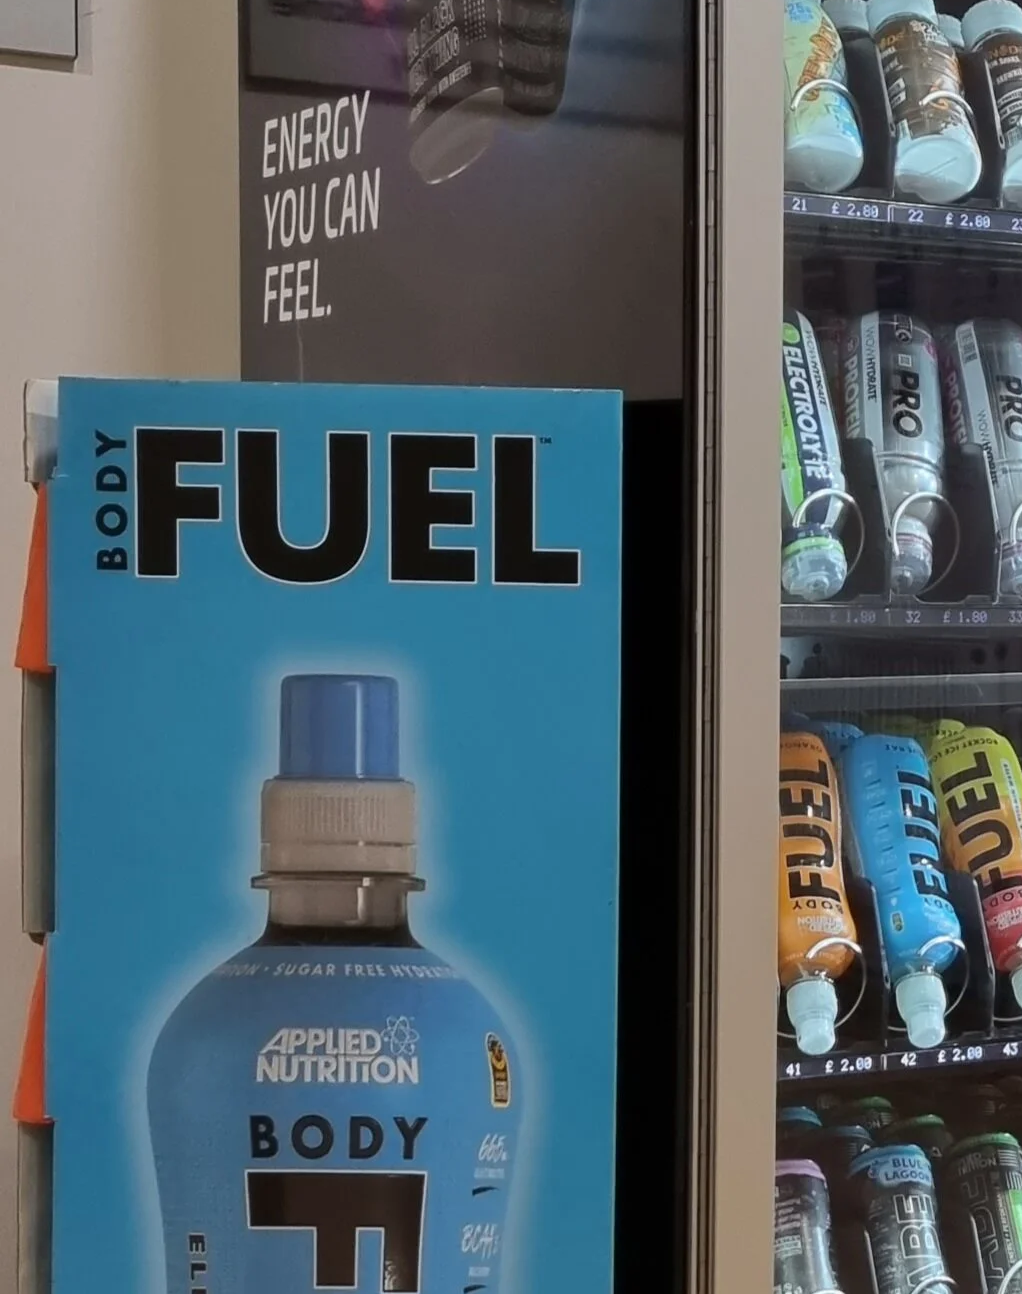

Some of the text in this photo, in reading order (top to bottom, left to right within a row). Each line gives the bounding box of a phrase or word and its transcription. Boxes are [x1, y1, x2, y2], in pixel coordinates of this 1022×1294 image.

[262, 90, 370, 178] ENERGY
[264, 168, 381, 250] YOU CAN
[792, 198, 807, 211] 21
[908, 209, 923, 222] 22
[263, 258, 332, 324] FEEL.
[864, 327, 878, 401] WOWHYDRATE
[783, 346, 829, 478] ELECTROLYTE
[892, 370, 923, 439] PRO
[94, 429, 129, 572] BODY
[132, 426, 582, 586] FUEL
[905, 611, 921, 624] 32
[779, 759, 842, 904] FUEL
[273, 962, 336, 977] SUGAR
[345, 963, 386, 978] FREE
[260, 1028, 382, 1055] APPLIED
[901, 1053, 917, 1066] 42
[1003, 1043, 1018, 1056] 43
[256, 1054, 419, 1084] NUTRITION
[786, 1063, 801, 1076] 41
[249, 1114, 429, 1161] BODY
[884, 1168, 930, 1181] LAGOON
